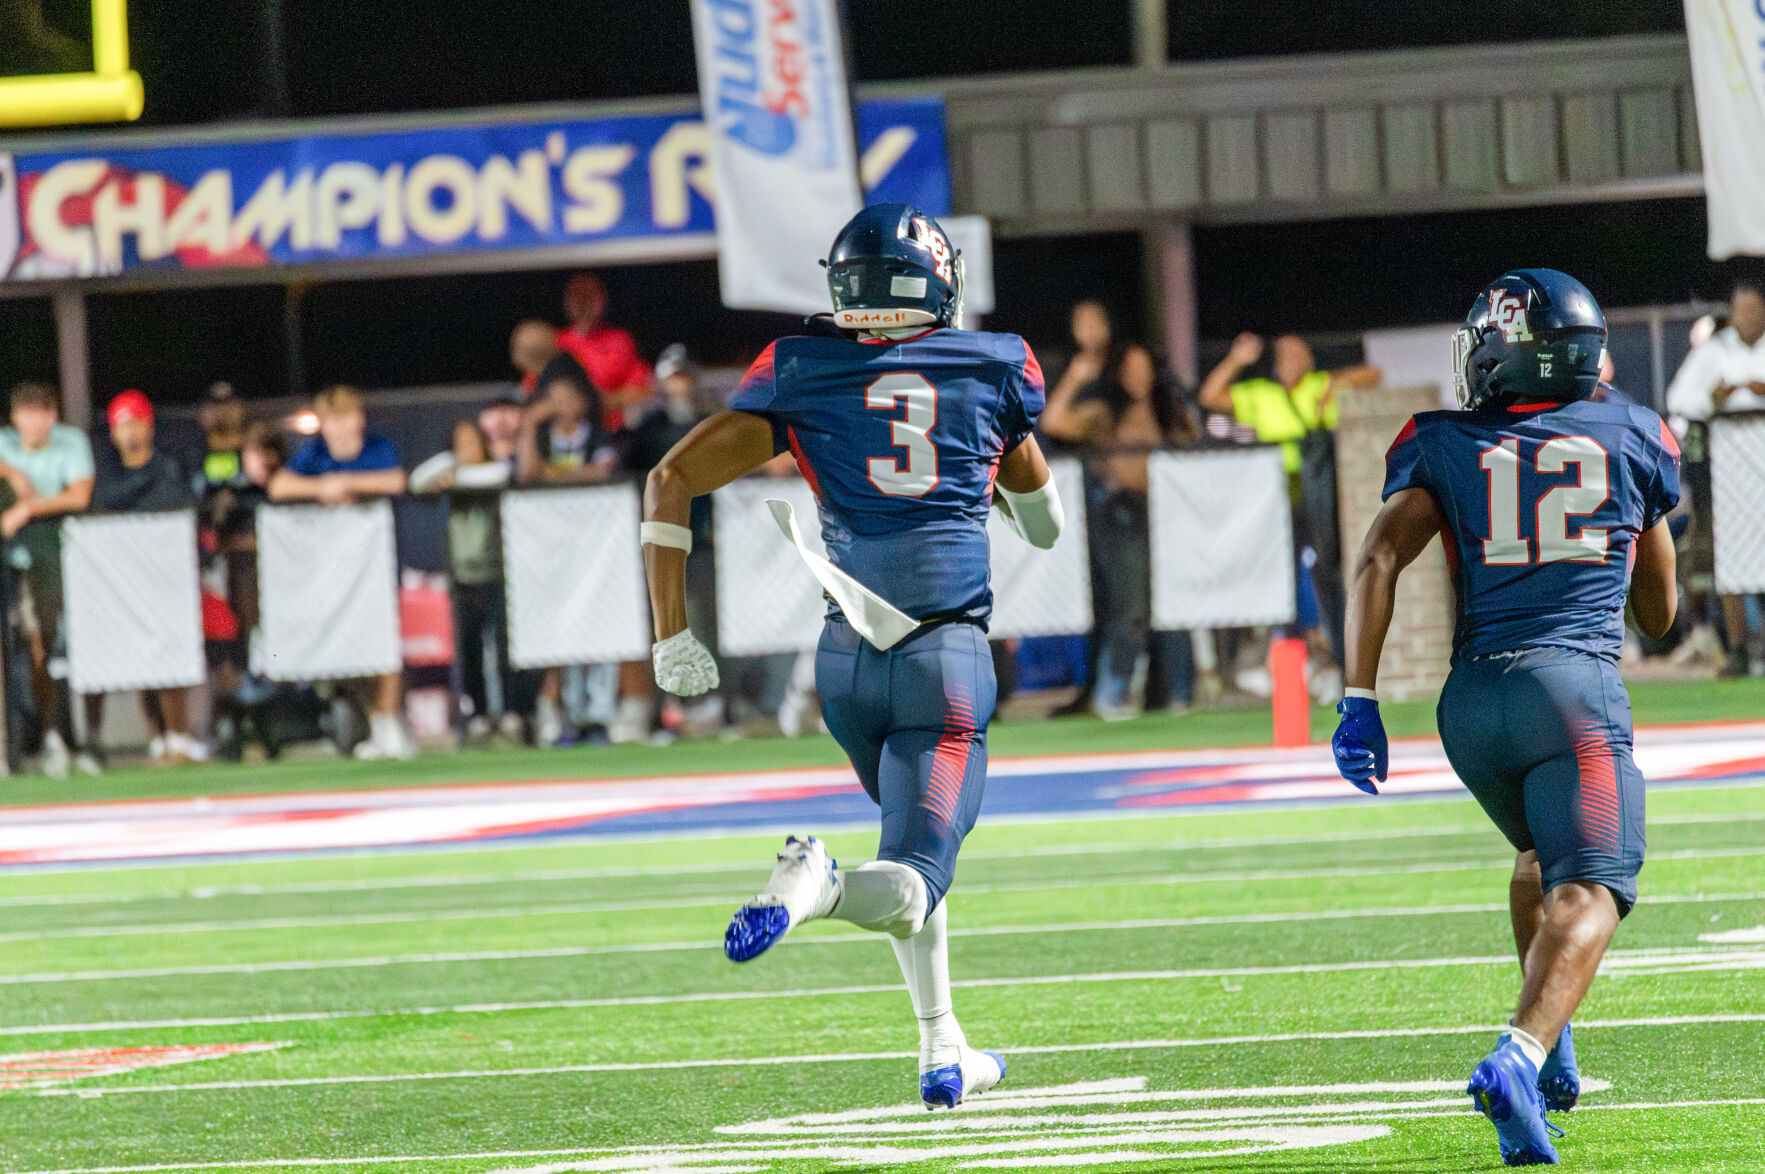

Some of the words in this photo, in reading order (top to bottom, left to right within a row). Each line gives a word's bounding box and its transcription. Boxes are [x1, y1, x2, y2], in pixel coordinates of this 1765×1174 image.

[1487, 288, 1534, 345] LCA
[1539, 362, 1553, 378] 12
[864, 371, 940, 499] 3
[1479, 435, 1610, 566] 12
